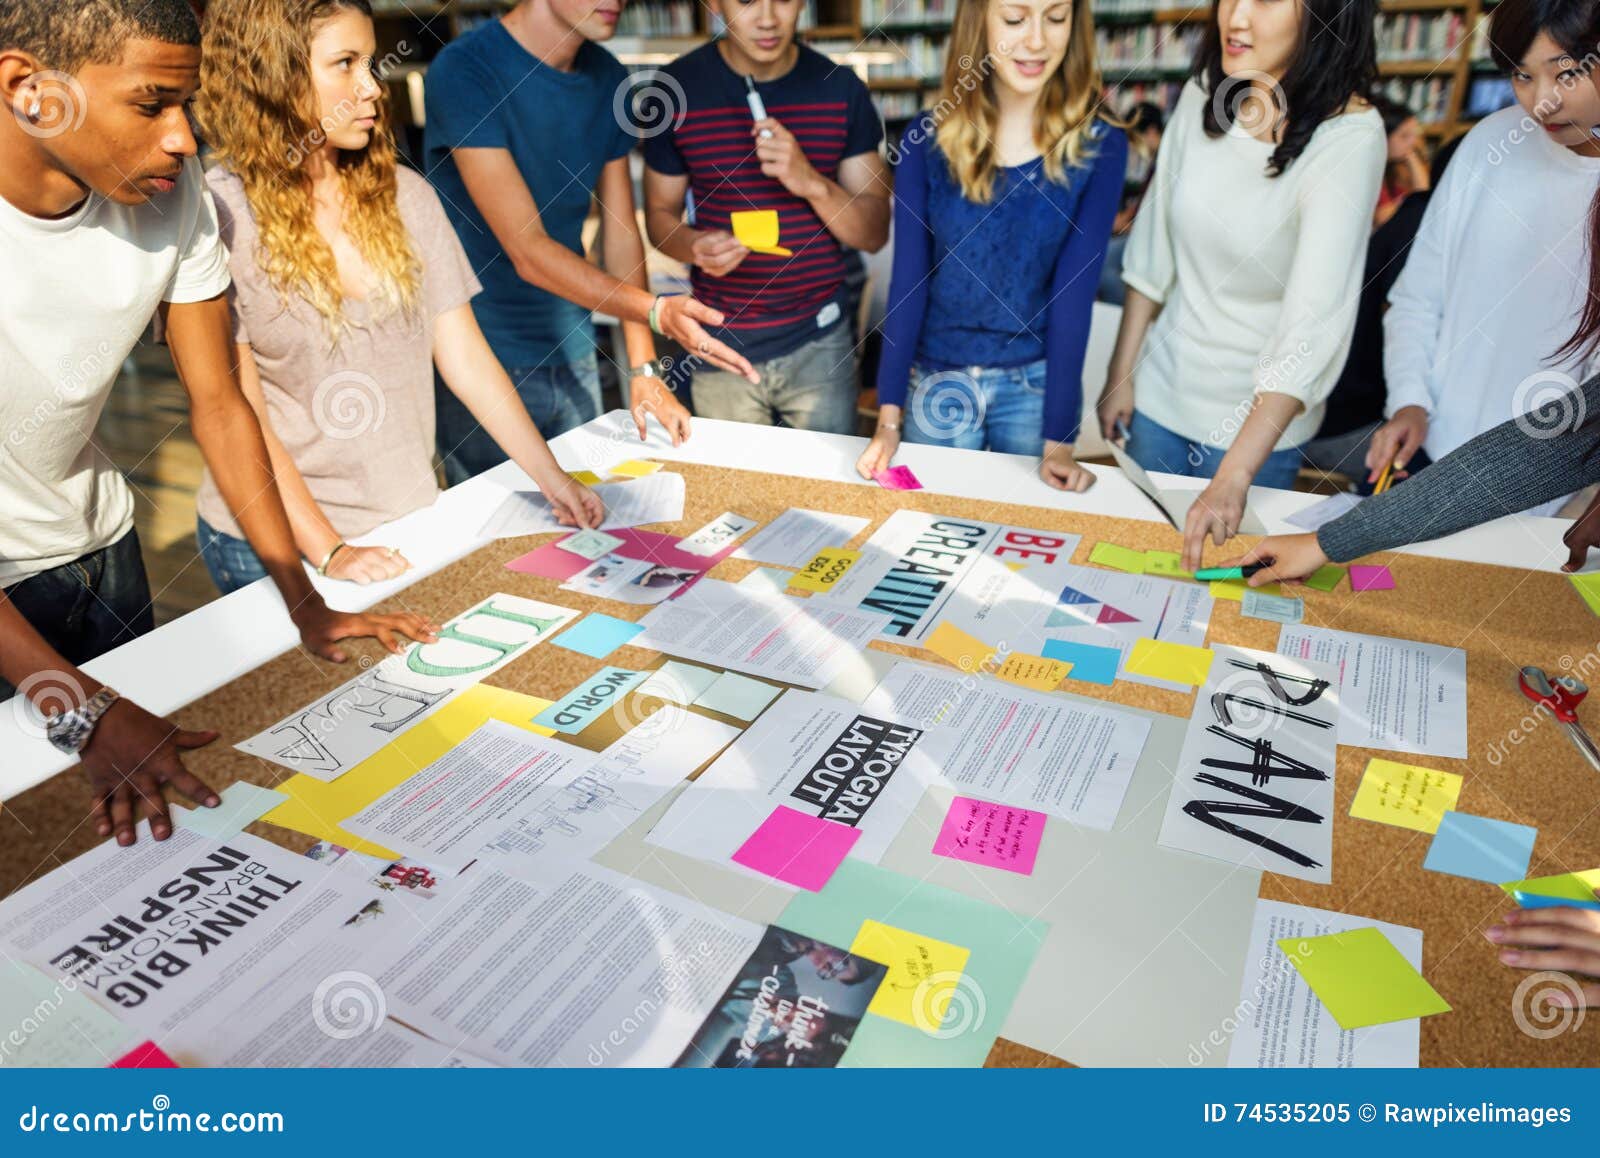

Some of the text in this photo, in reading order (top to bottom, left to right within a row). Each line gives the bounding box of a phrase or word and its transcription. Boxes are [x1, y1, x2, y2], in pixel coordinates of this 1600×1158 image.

[807, 556, 831, 574] IDEA
[820, 558, 852, 585] GOOD
[994, 531, 1065, 565] BE
[271, 601, 564, 771] IDEA
[554, 672, 636, 727] WORLD
[801, 720, 884, 803] LAYOUT
[822, 729, 919, 824] TYPOGRA
[1183, 658, 1335, 869] PLAN
[49, 846, 251, 977] INSPIRE
[83, 861, 268, 990] BRAINSTORM
[174, 873, 302, 956] THINK
[106, 950, 191, 1008] BIG
[784, 994, 830, 1050] think
